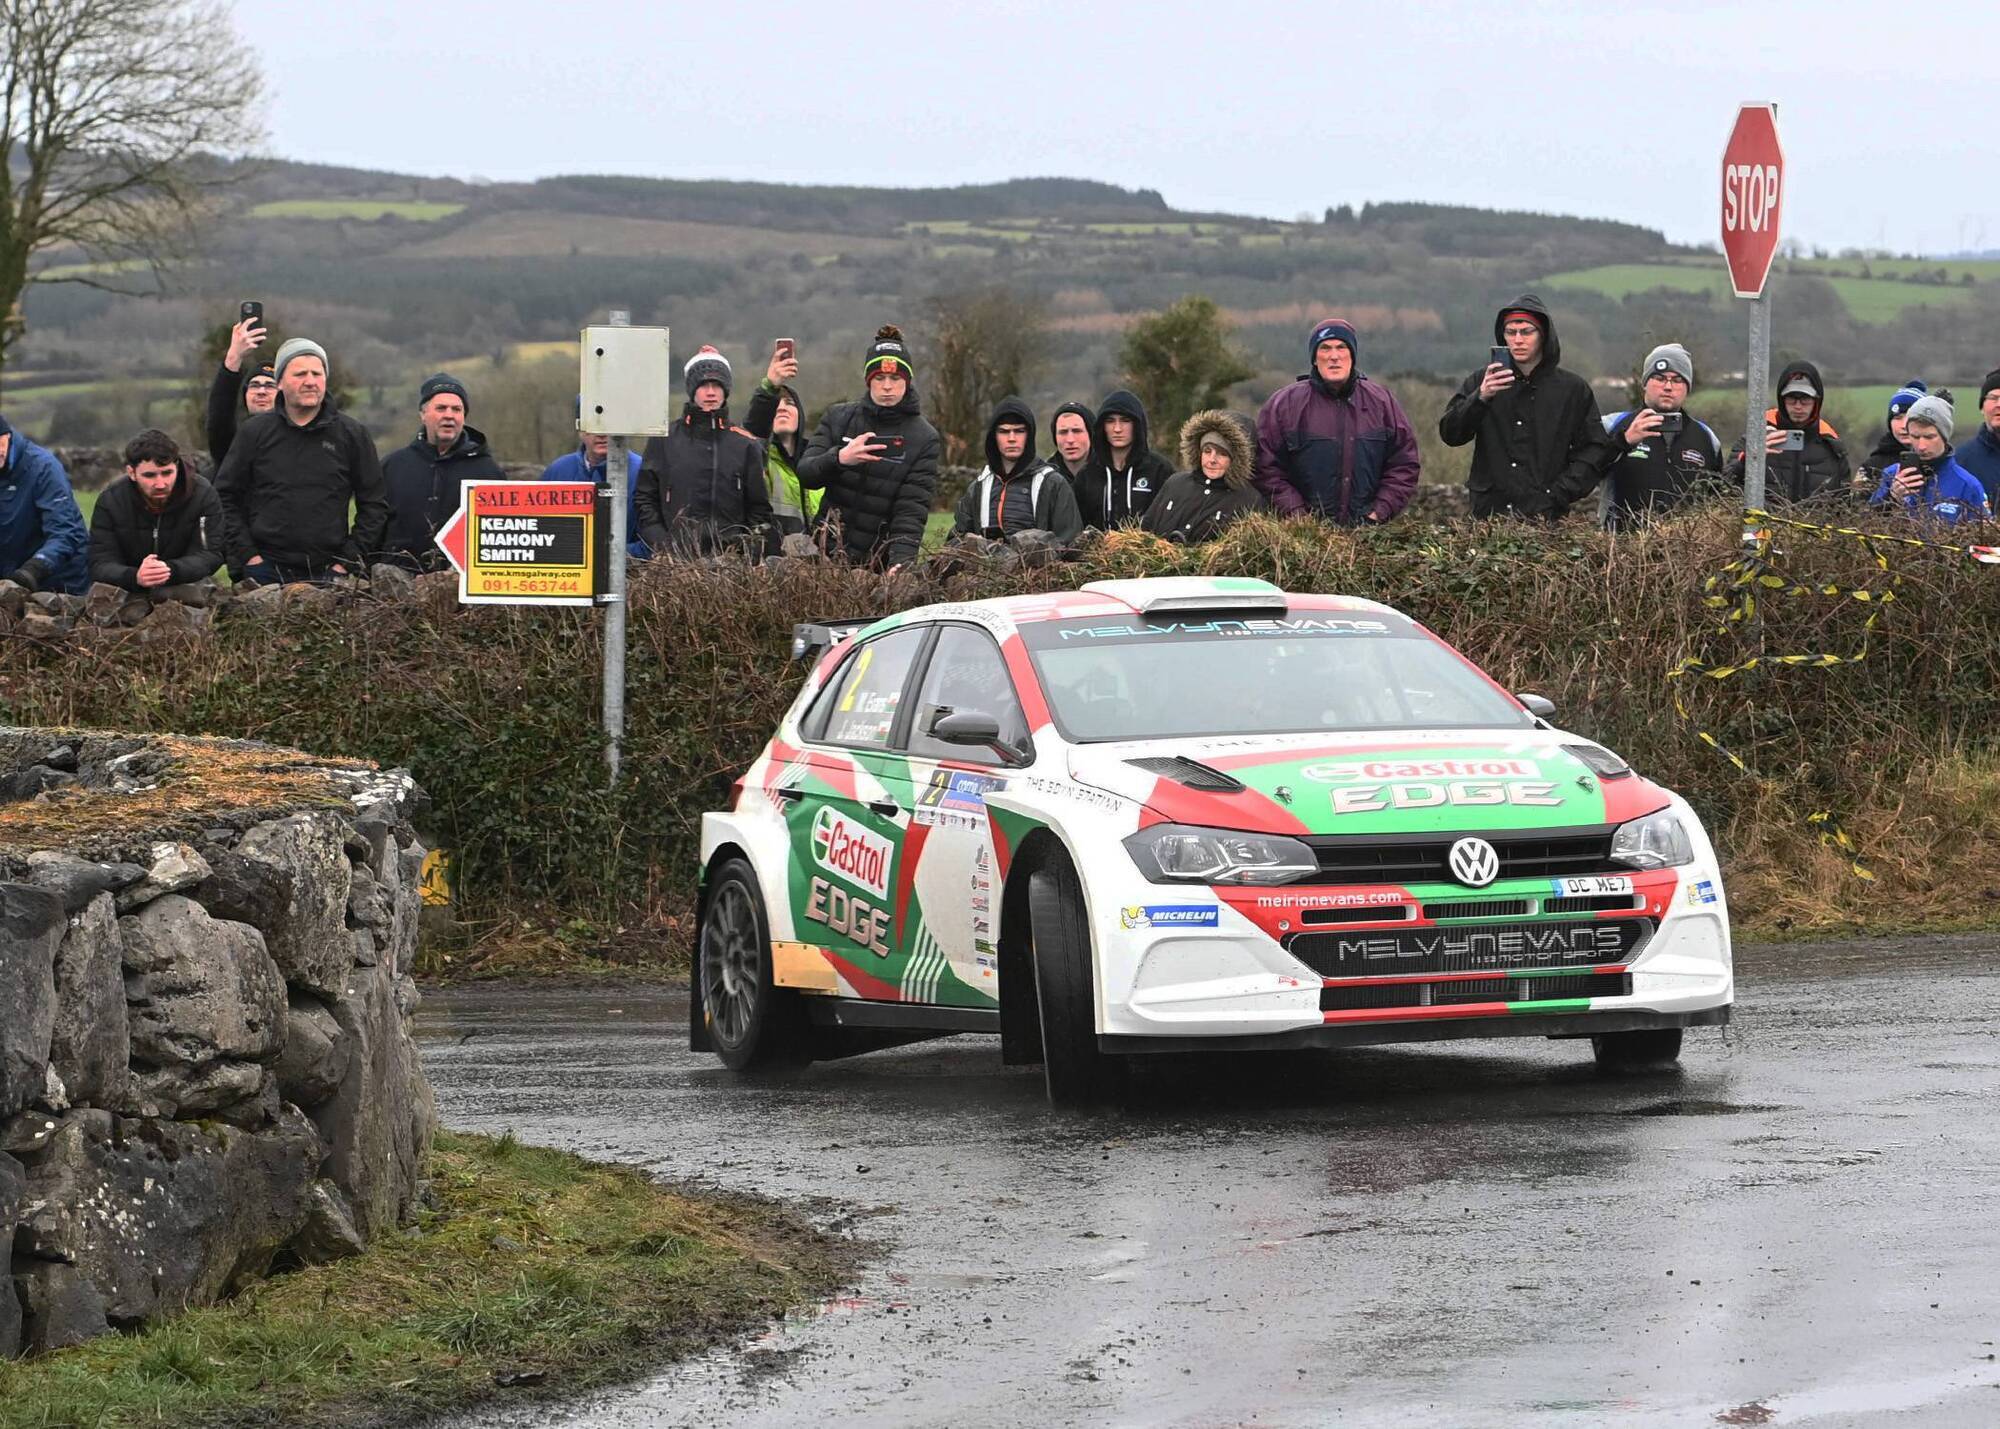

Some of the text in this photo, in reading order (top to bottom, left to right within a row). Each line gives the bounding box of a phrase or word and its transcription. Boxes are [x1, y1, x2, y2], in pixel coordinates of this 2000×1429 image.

[1725, 164, 1778, 232] STOP
[478, 490, 594, 507] SALE AGREED
[480, 518, 538, 531] KEANE
[480, 533, 555, 547] MAHONY
[480, 549, 535, 561] SMITH
[481, 570, 581, 579] www.kmsgalway.com
[483, 580, 578, 592] 091-563744
[839, 647, 874, 712] 2
[1362, 760, 1529, 779] Castrol
[925, 772, 945, 804] 2
[1330, 781, 1567, 815] EDGE
[828, 820, 887, 890] Castrol
[1257, 892, 1402, 908] meirionevans.com
[804, 875, 892, 959] EDGE
[1152, 911, 1217, 921] MICHELIN
